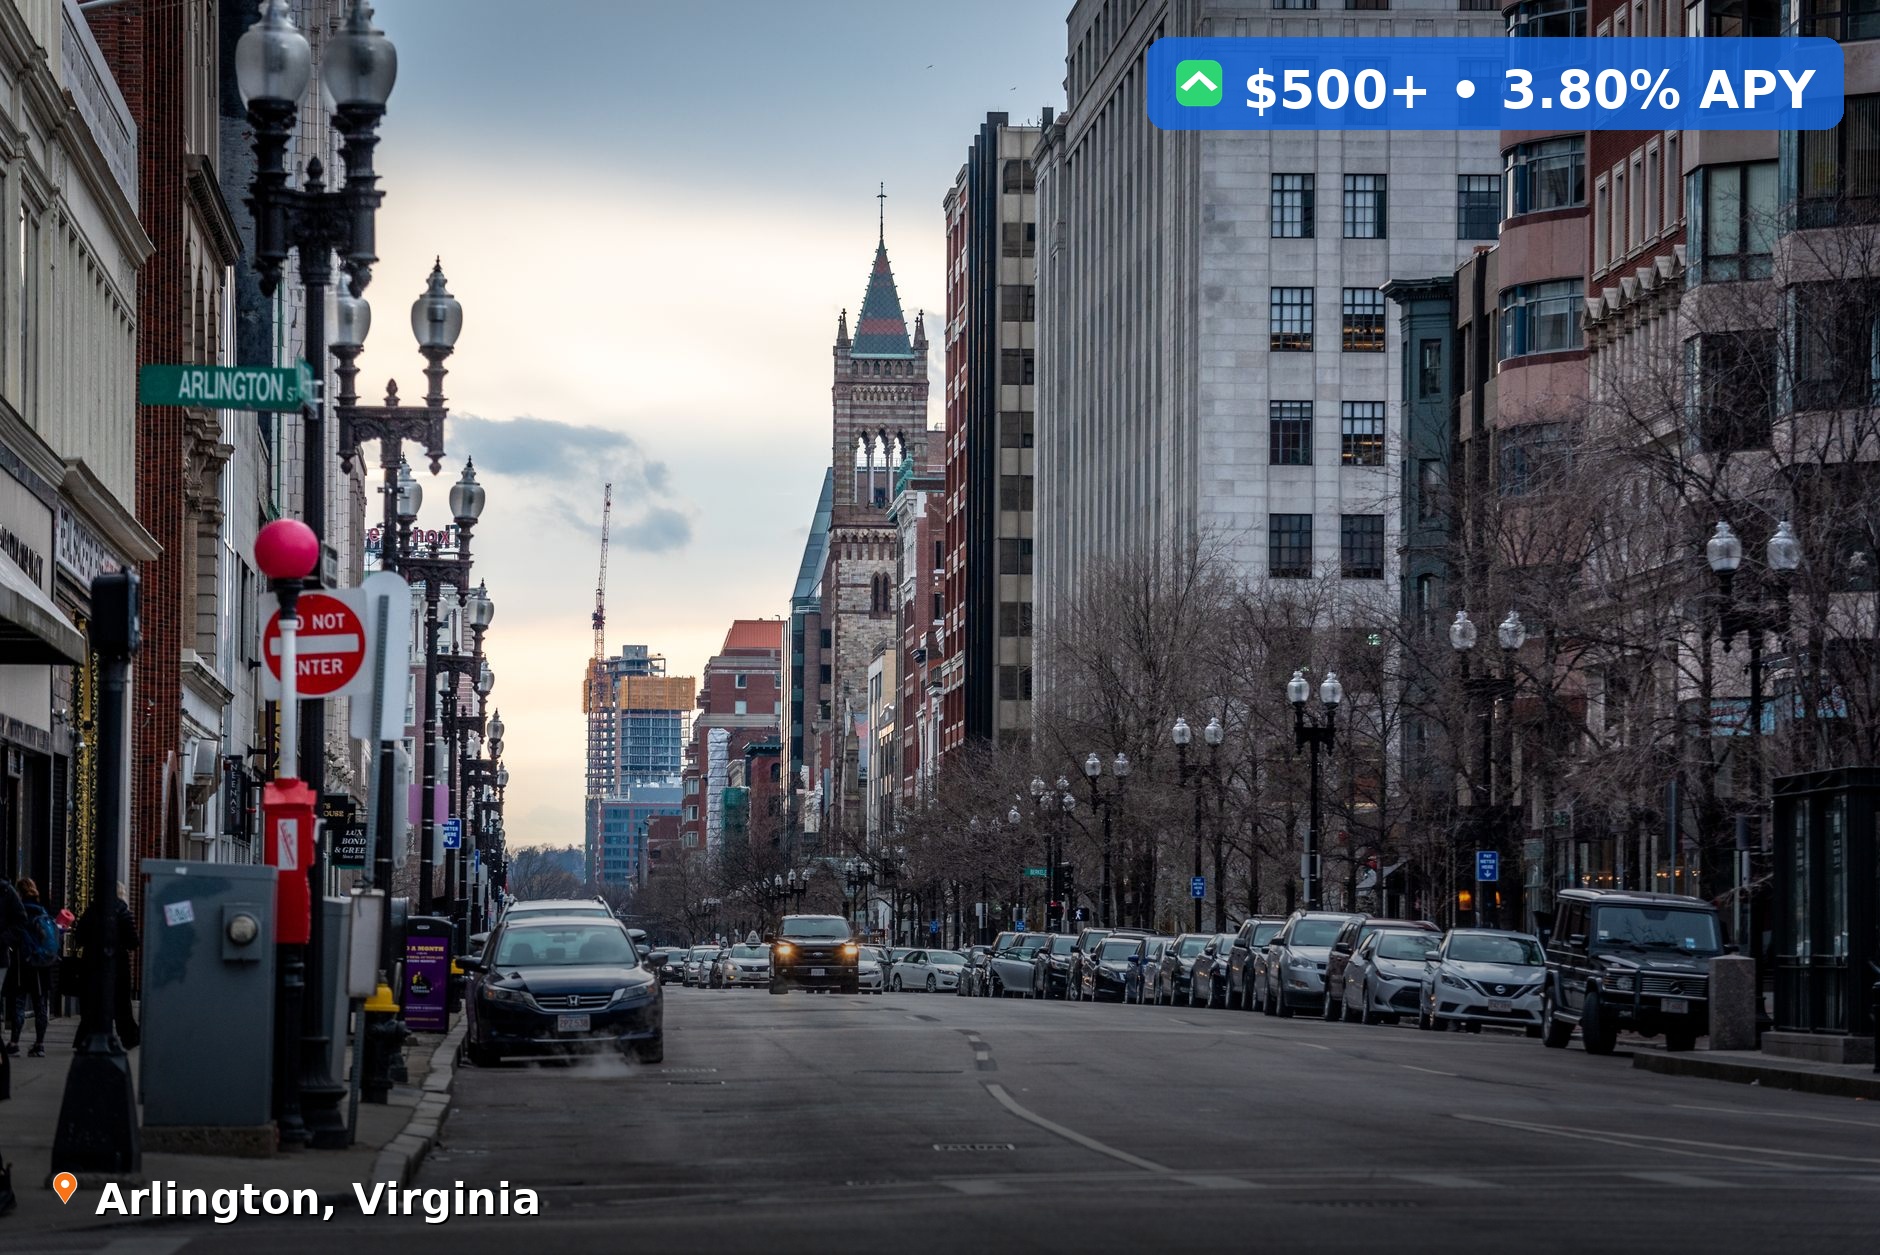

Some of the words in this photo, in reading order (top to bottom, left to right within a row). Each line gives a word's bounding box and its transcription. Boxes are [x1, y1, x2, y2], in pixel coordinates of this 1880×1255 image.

[178, 370, 283, 401] ARLINGTON
[296, 614, 305, 630] O
[312, 612, 345, 630] NOT
[297, 658, 343, 676] NTER
